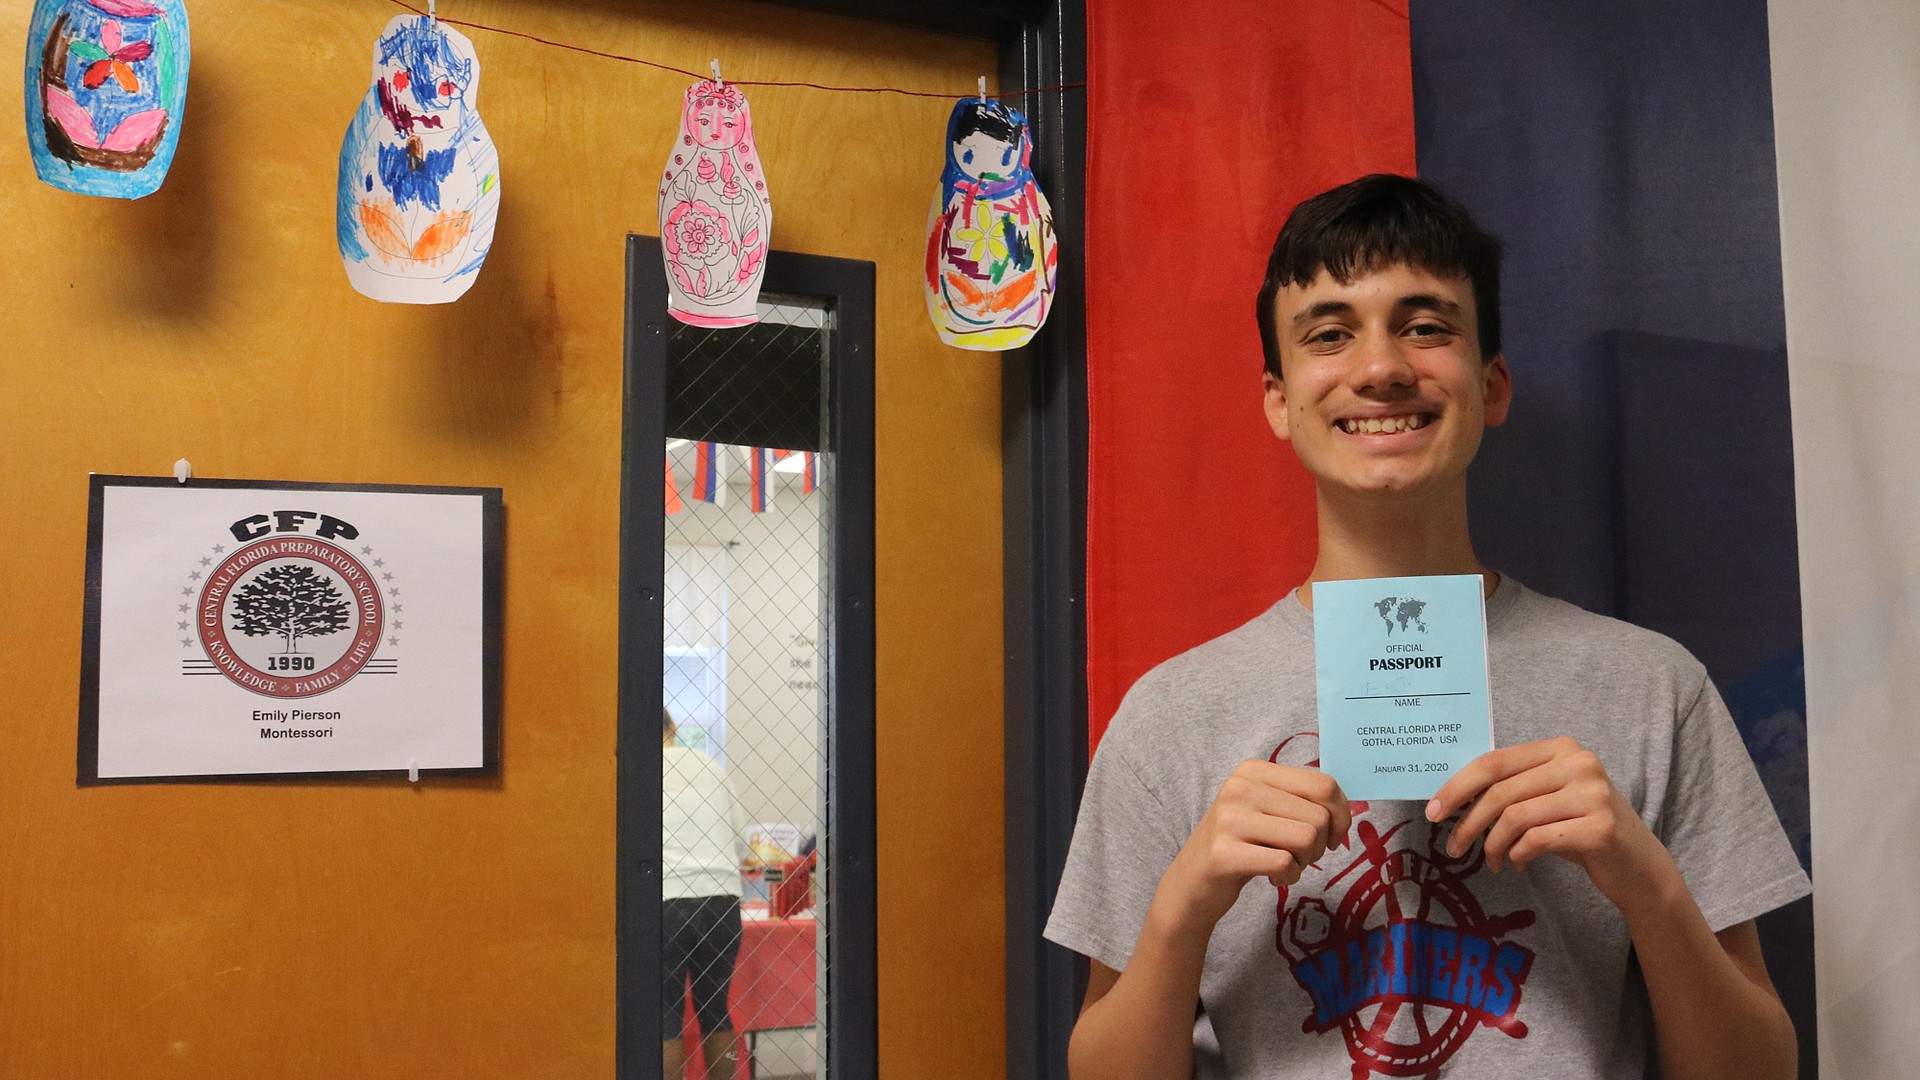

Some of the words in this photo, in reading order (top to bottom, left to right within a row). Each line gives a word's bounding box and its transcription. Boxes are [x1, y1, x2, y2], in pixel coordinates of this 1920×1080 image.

[229, 510, 360, 543] CFP
[204, 575, 232, 627] CENTRAL
[225, 544, 279, 576] FLORIDA
[280, 542, 363, 582] PREPARATORY
[355, 580, 377, 627] SCHOOL
[1385, 644, 1425, 654] OFFICIAL
[209, 640, 277, 692] KNOWLEDGE
[295, 669, 341, 693] FAMILY
[349, 639, 372, 664] LIFE
[267, 656, 315, 671] 1990
[1369, 655, 1443, 671] PASSPORT
[1394, 698, 1421, 707] NAME
[252, 710, 288, 723] Emily
[291, 709, 341, 720] Pierson
[260, 727, 333, 739] Montessori
[1357, 726, 1397, 736] CENTRAL
[1398, 725, 1437, 734] FLORIDA
[1438, 723, 1462, 732] PREP
[1361, 737, 1395, 747] GOTHA,
[1396, 736, 1434, 745] FLORIDA
[1439, 735, 1458, 744] USA
[1407, 764, 1423, 774] 31,
[1424, 763, 1449, 772] 2020
[1380, 851, 1441, 885] CFP
[1295, 922, 1526, 1026] MARINERS
